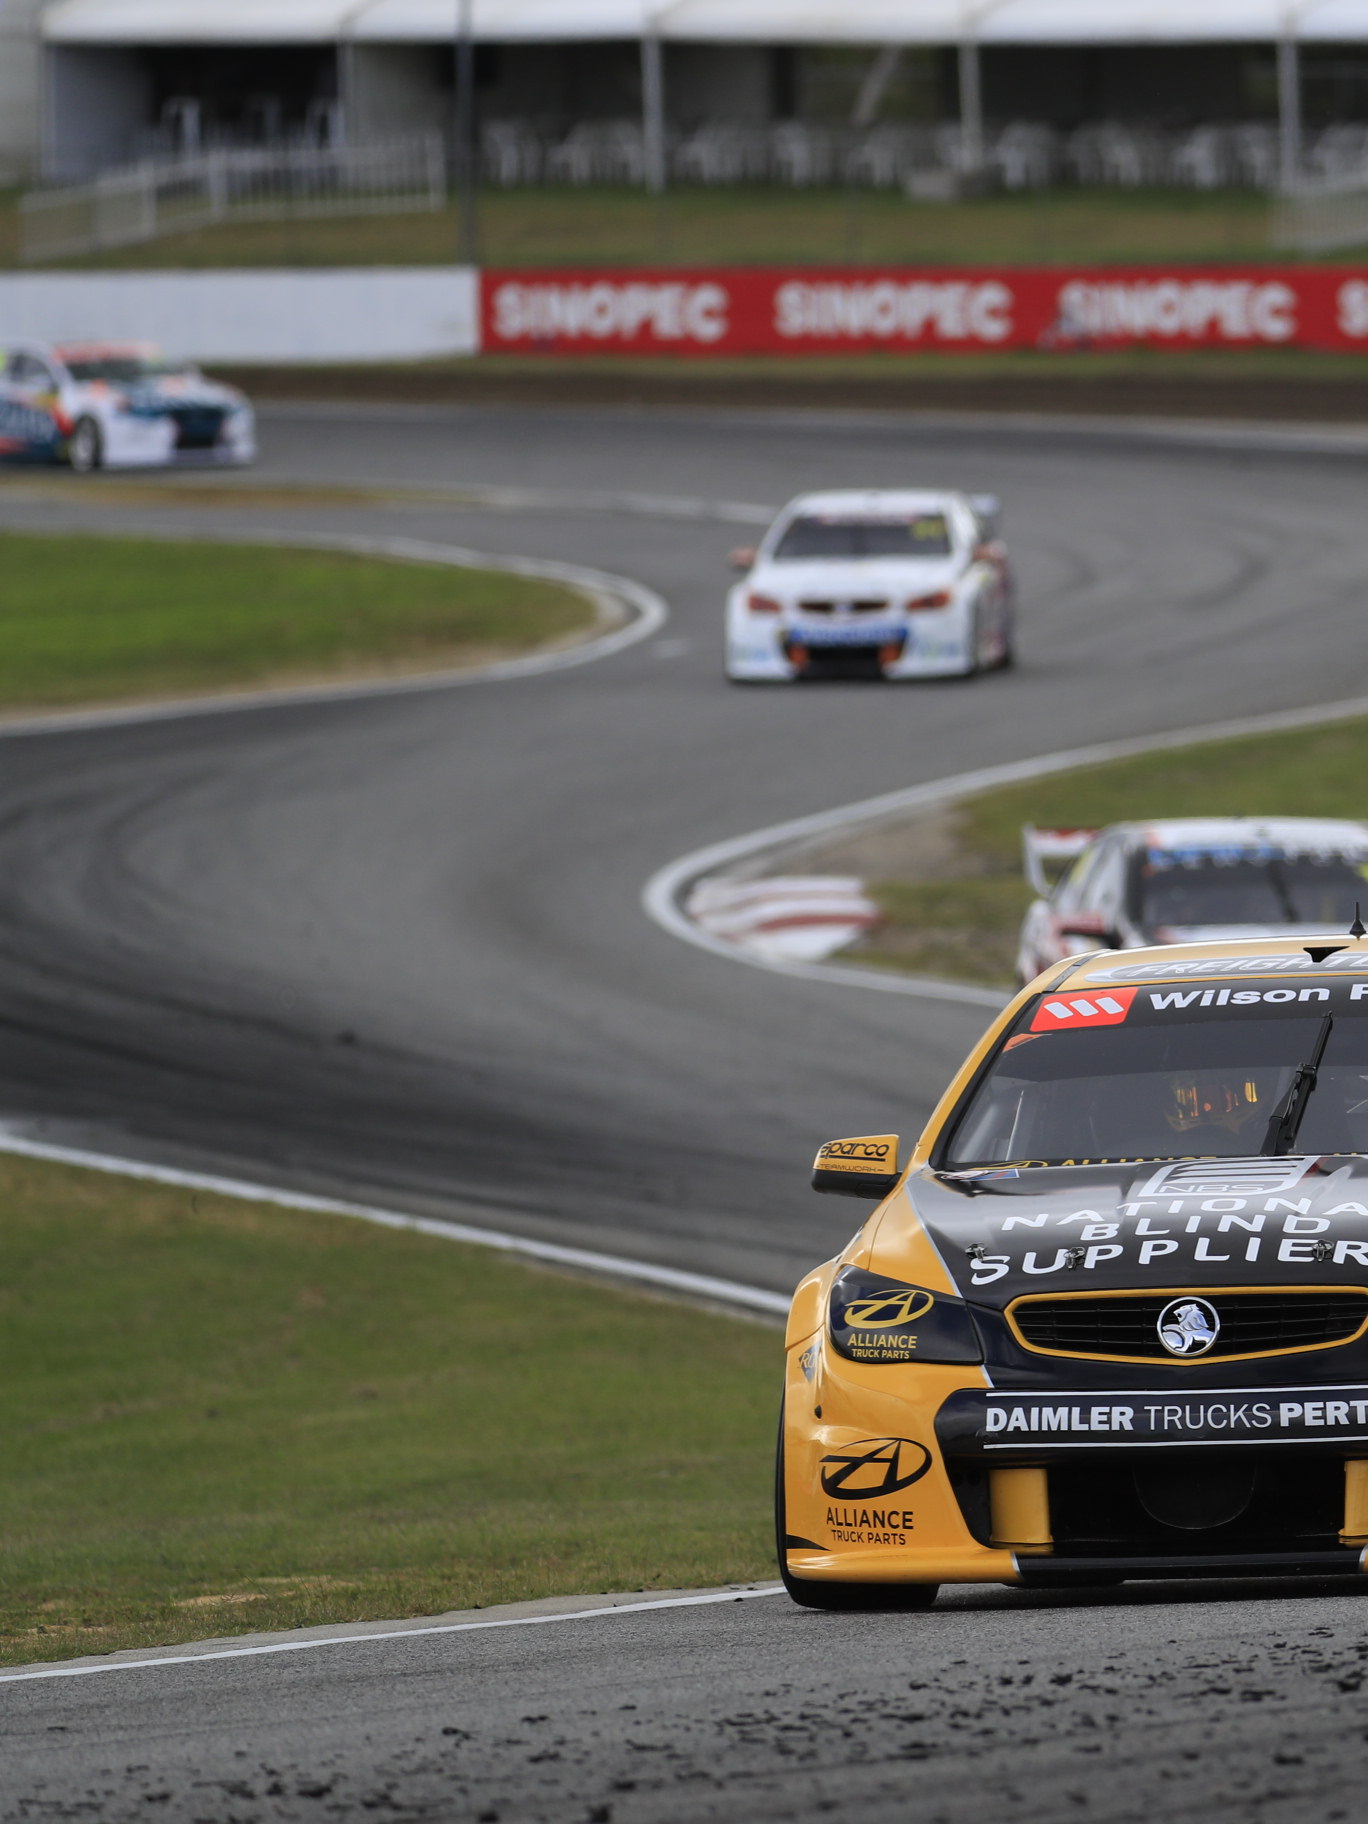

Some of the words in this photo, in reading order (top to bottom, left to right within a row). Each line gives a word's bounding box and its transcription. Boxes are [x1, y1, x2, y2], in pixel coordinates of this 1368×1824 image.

[493, 281, 730, 342] SINOPEC
[773, 280, 1013, 341] SINOPEC
[1058, 280, 1296, 342] SINOPEC
[1149, 984, 1331, 1009] Wilson
[820, 1142, 889, 1159] sparco
[1159, 1184, 1265, 1193] NBS
[1080, 1214, 1331, 1241] BLIND
[847, 1333, 918, 1349] ALLIANCE
[851, 1348, 880, 1358] TRUCK
[882, 1349, 910, 1360] PARTS
[986, 1406, 1134, 1432] DAIMLER
[1144, 1403, 1272, 1430] TRUCKS
[826, 1507, 914, 1530] ALLIANCE
[831, 1529, 865, 1543] TRUCK
[867, 1532, 906, 1545] PARTS
